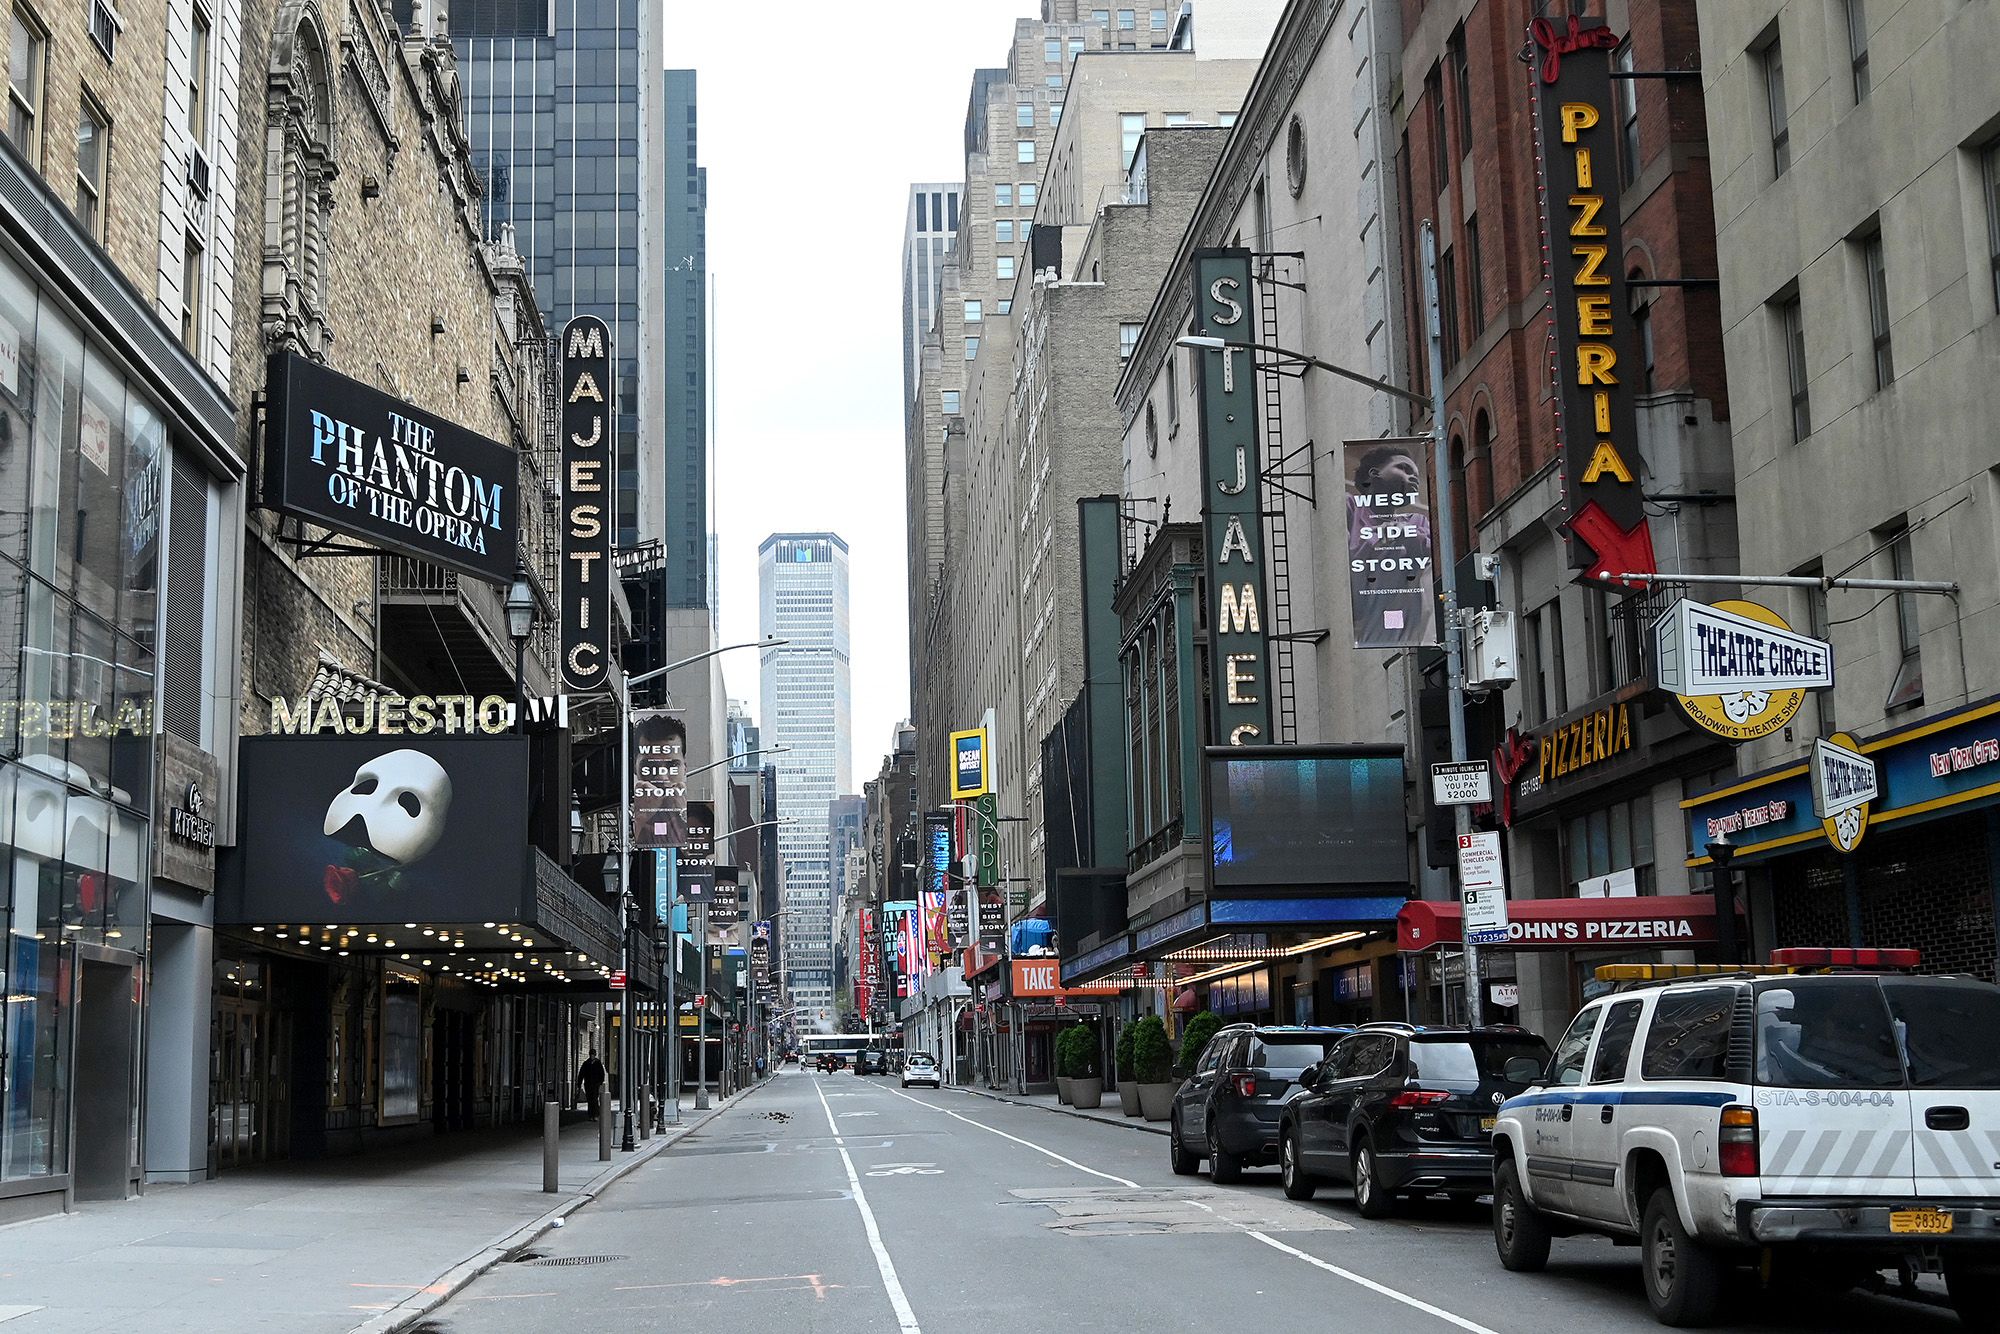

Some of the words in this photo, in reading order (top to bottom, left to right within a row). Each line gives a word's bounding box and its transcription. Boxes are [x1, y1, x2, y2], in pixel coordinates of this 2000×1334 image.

[1560, 102, 1634, 483] PIZZERIA
[388, 410, 436, 456] THE
[309, 409, 504, 530] PHANTOM
[568, 327, 604, 676] MAJESTIC
[1354, 492, 1419, 508] WEST
[328, 473, 362, 509] OF
[364, 486, 412, 528] THE
[415, 506, 488, 556] OPERA
[1360, 525, 1418, 540] SIDE
[1351, 557, 1430, 572] STORY
[1697, 622, 1765, 677] THEATRE
[1769, 641, 1822, 677] CIRCLE
[271, 695, 509, 735] MAJESTIC
[1685, 700, 1738, 737] BROADWAY'S
[1742, 714, 1783, 737] THEATRE
[1781, 691, 1800, 717] SHOP
[639, 745, 681, 754] WEST
[1540, 703, 1631, 784] PIZZERIA
[959, 750, 980, 762] OCEAN
[1930, 753, 1951, 778] NEW
[1950, 744, 1974, 772] YORK
[1973, 740, 1999, 766] GIFTS
[641, 766, 679, 776] SIDE
[635, 788, 686, 797] STORY
[1447, 790, 1478, 798] $2000
[175, 808, 215, 848] KITCHEN
[1707, 810, 1743, 837] BROADWAY'S
[1742, 805, 1770, 828] THEATRE
[1769, 801, 1787, 821] SHOP
[1462, 836, 1469, 847] 3
[676, 858, 715, 866] STORY
[1462, 850, 1494, 858] COMMERCIAL
[1467, 892, 1474, 902] 6
[1507, 922, 1578, 940] OHN'S
[1586, 920, 1693, 939] PIZZERIA
[1022, 967, 1055, 990] TAKE
[1757, 1090, 1895, 1107] STA-S-004-04
